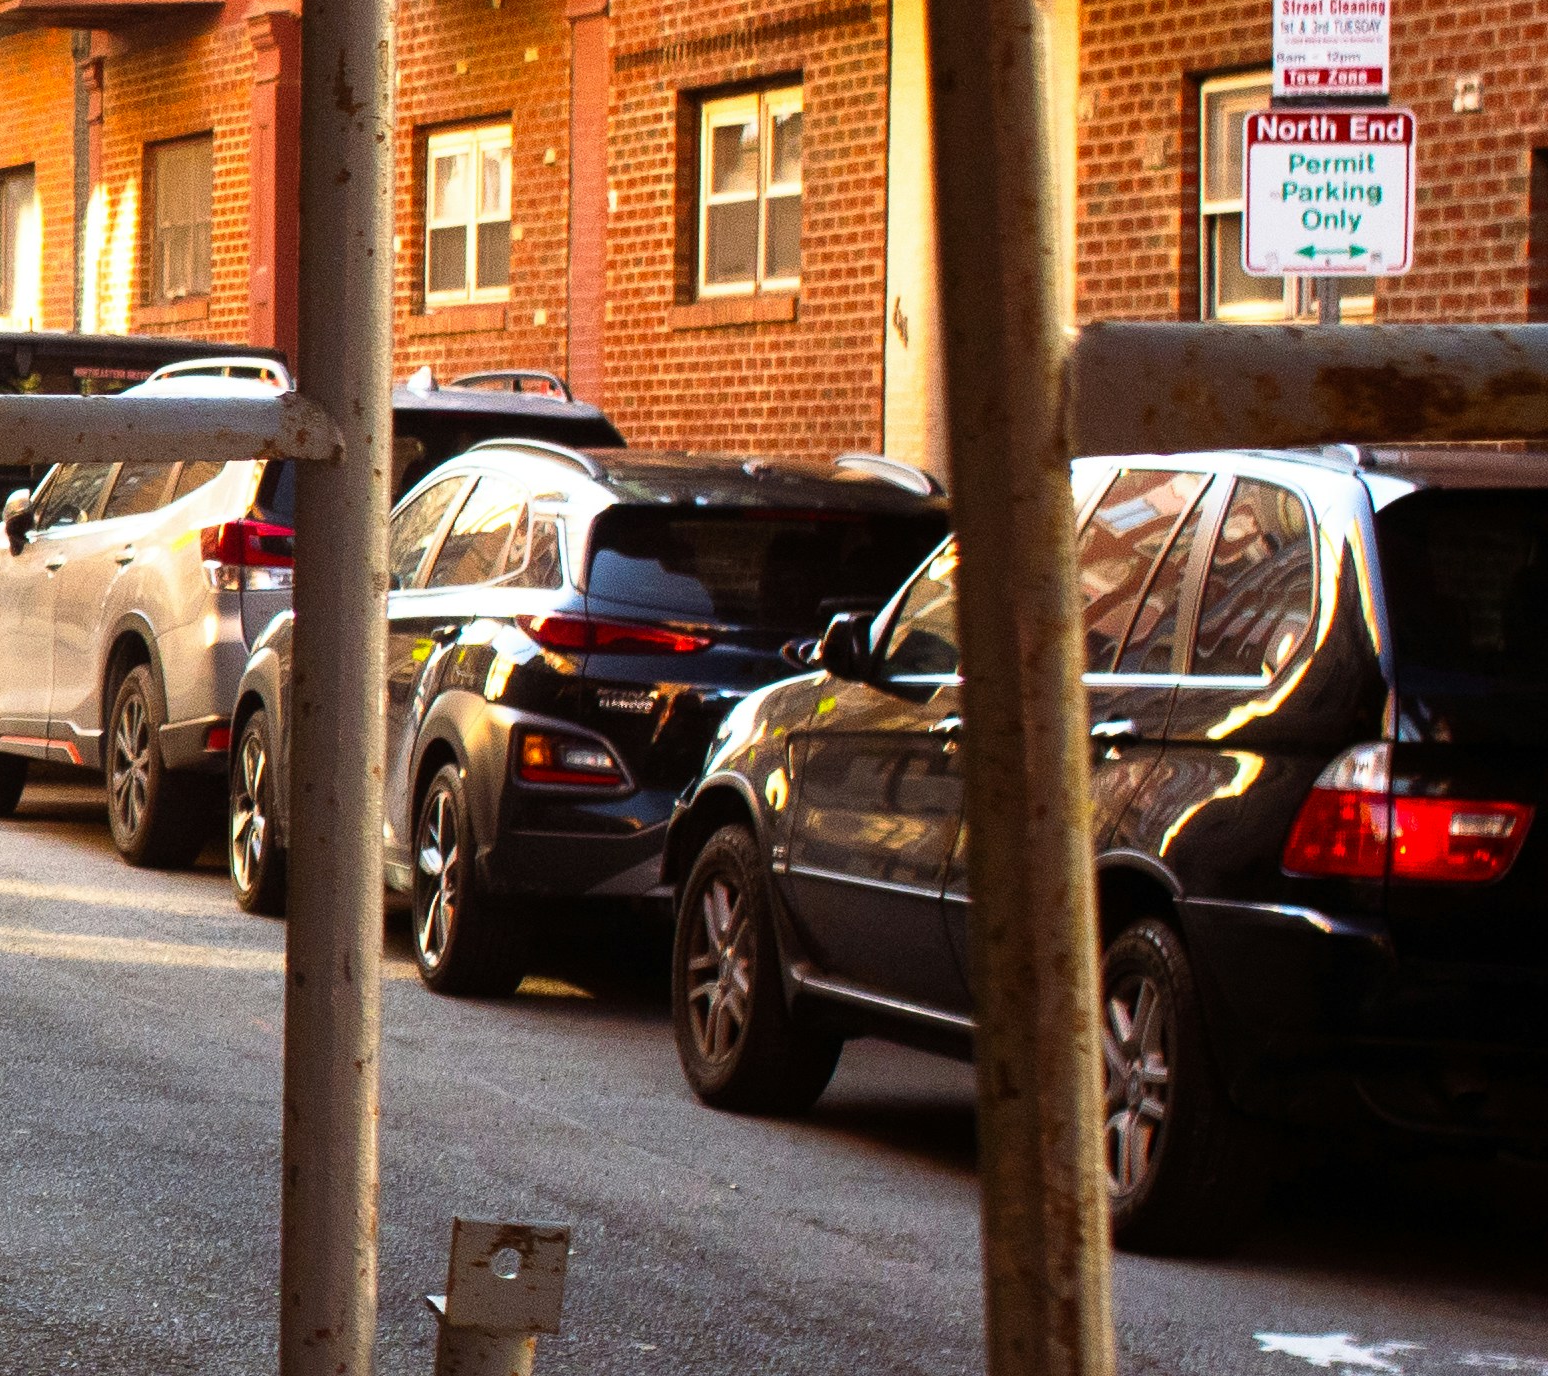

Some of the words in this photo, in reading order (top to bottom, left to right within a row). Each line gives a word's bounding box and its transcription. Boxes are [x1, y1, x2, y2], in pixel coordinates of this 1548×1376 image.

[1282, 0, 1323, 16] Street
[1290, 70, 1319, 86] Tow
[1328, 69, 1368, 86] Zone
[1257, 115, 1337, 141] North
[1349, 115, 1404, 141] End
[1289, 152, 1375, 174] Permit
[1282, 180, 1383, 206] Parking
[1301, 208, 1362, 234] Only
